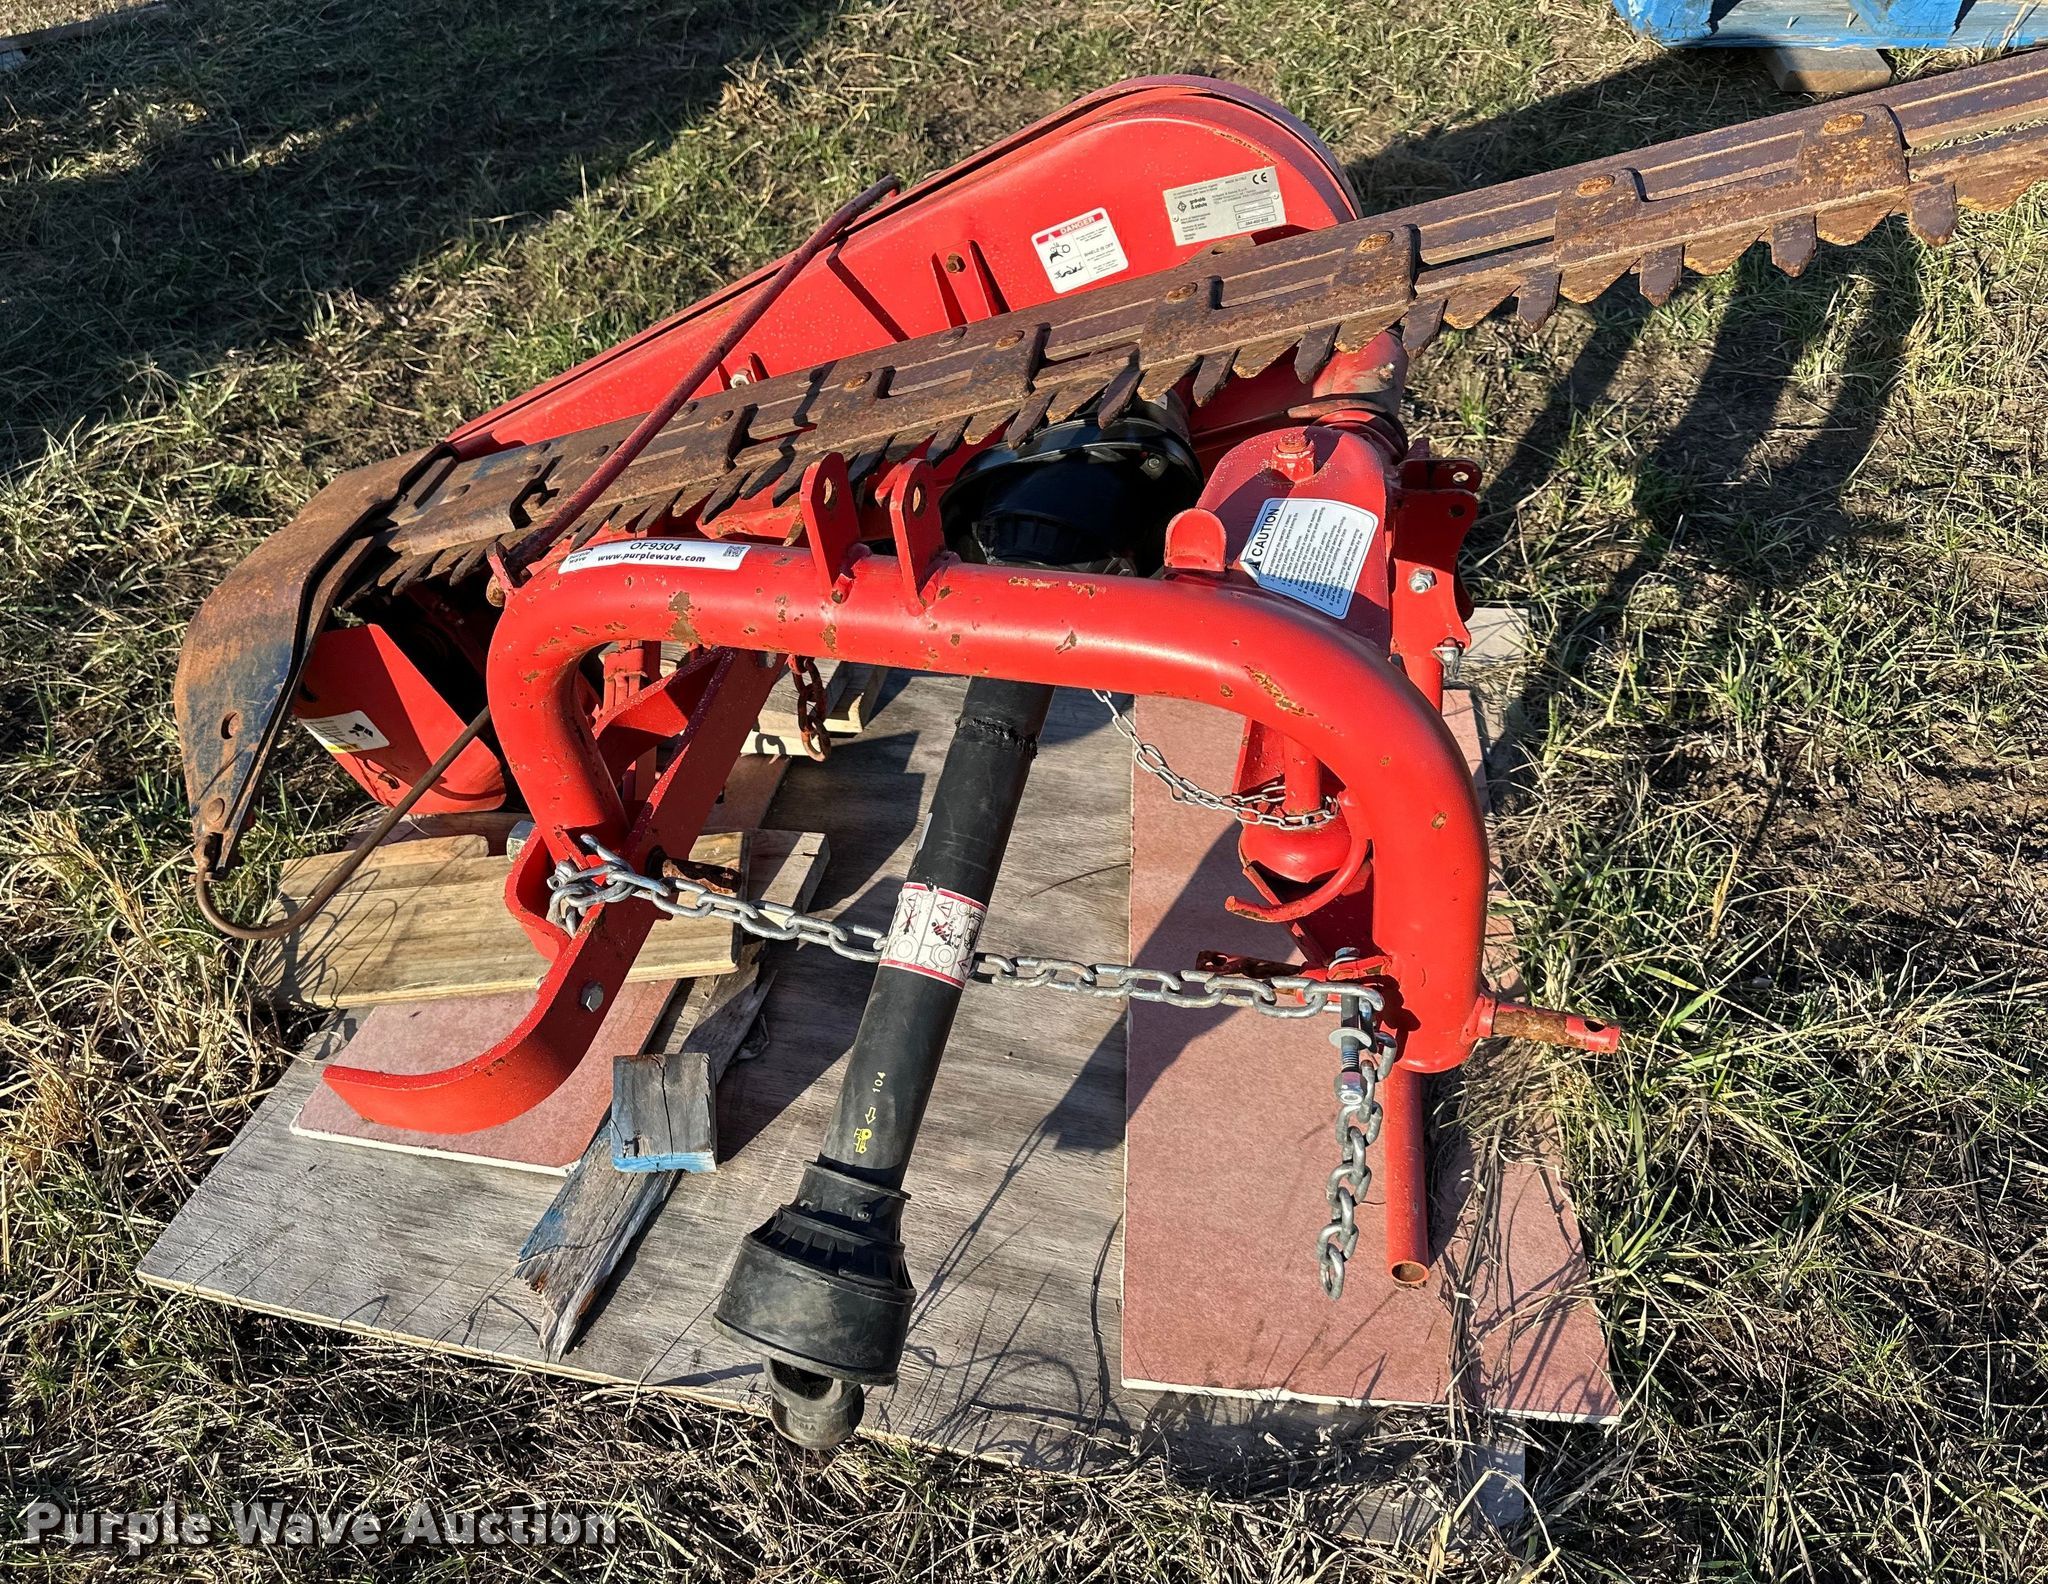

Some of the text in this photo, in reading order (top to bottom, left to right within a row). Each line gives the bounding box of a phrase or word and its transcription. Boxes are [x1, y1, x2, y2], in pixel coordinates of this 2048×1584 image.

[1252, 172, 1267, 184] CE
[1060, 217, 1095, 235] DANGER
[1252, 508, 1280, 556] CAUTION
[597, 551, 706, 562] www.purplewave.com
[872, 1071, 886, 1093] 104
